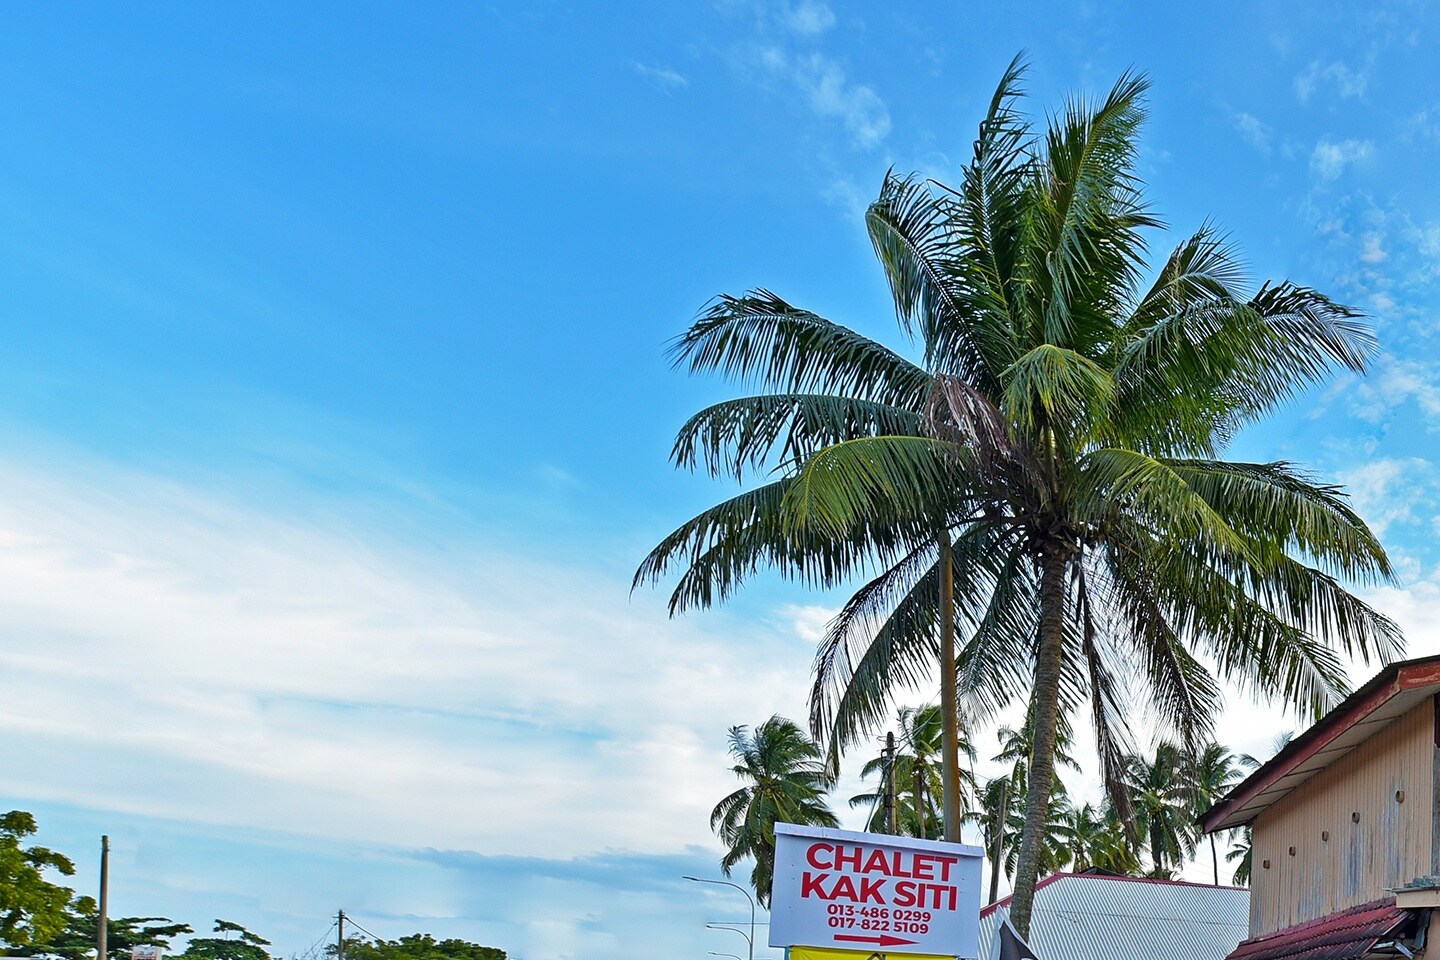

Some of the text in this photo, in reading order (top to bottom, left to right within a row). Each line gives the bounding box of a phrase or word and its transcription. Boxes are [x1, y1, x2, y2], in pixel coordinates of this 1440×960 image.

[806, 843, 958, 882] CHALET
[801, 872, 958, 910] KAK SITI
[827, 904, 931, 922] 013-486 0299
[828, 916, 929, 934] 017-822 5109
